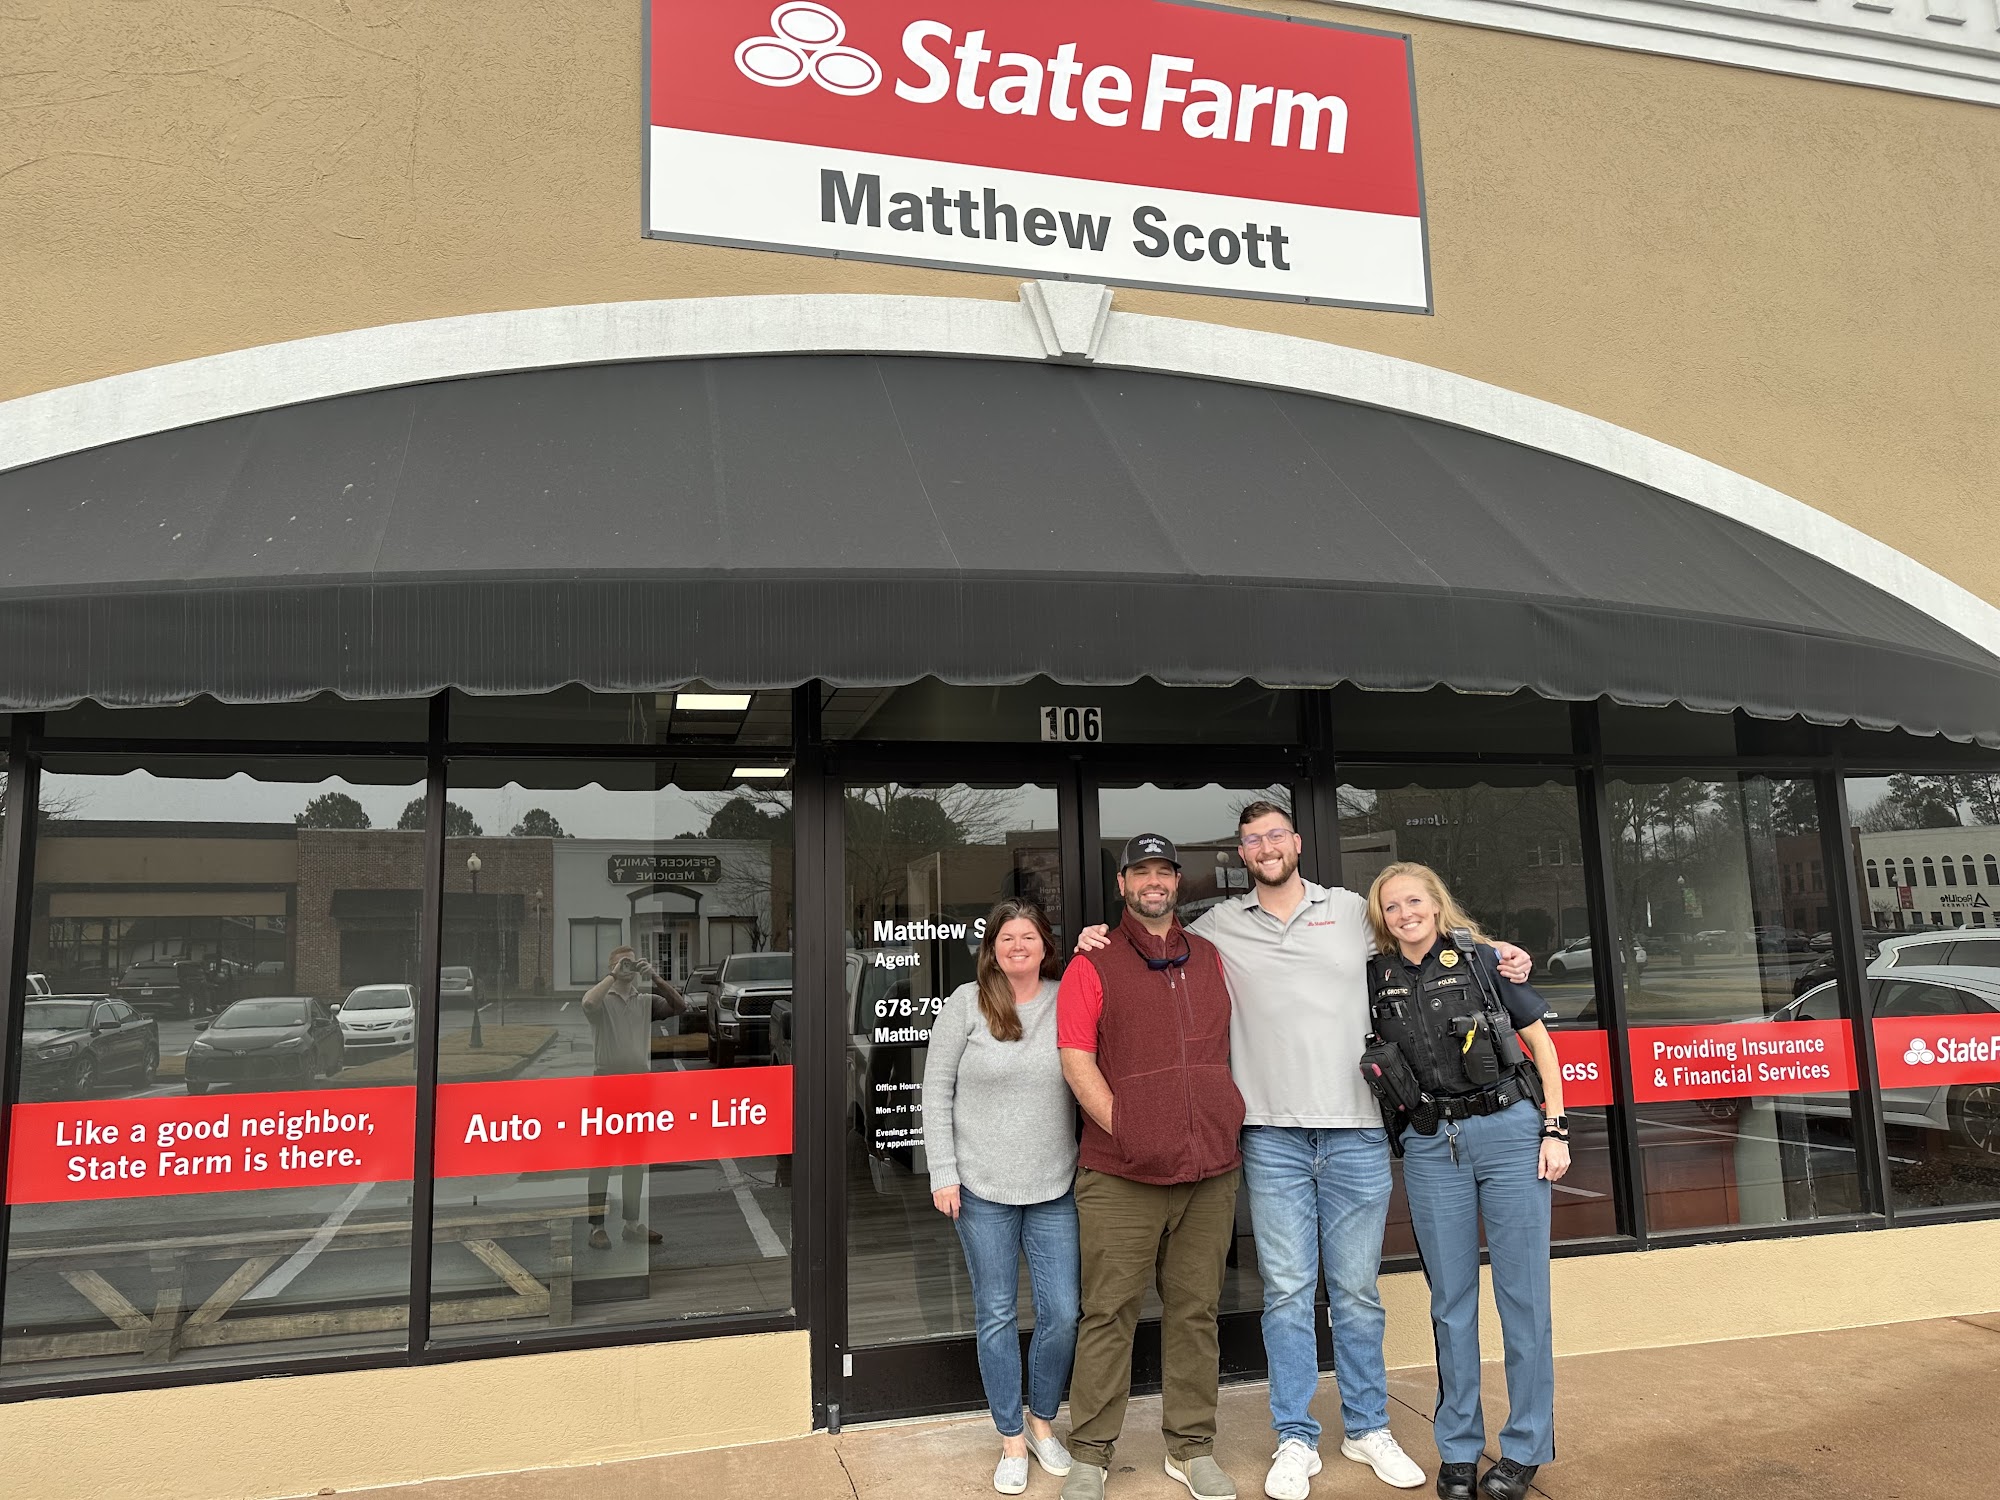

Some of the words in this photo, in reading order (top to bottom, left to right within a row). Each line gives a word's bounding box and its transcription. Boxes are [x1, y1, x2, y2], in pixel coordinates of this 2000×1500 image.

[820, 168, 1112, 252] Matthew
[1132, 204, 1291, 271] Scott
[1045, 707, 1100, 741] 106
[873, 919, 967, 942] Matthew
[874, 952, 920, 970] Agent
[1437, 977, 1457, 986] POLICE
[1653, 1039, 1737, 1061] Providing
[1742, 1038, 1825, 1056] Insurance
[1562, 1062, 1599, 1082] ess
[1653, 1067, 1668, 1087] &
[1673, 1063, 1752, 1086] Financial
[1758, 1061, 1830, 1082] Services
[876, 1083, 897, 1091] Office
[899, 1082, 923, 1090] Hours:
[56, 1119, 119, 1147] Like
[130, 1123, 146, 1143] a
[157, 1113, 230, 1148] good
[241, 1108, 375, 1141] neighbor,
[463, 1114, 542, 1144] Auto
[580, 1106, 675, 1137] Home
[711, 1098, 767, 1128] Life
[876, 1128, 908, 1137] Evenings
[909, 1127, 923, 1135] and
[876, 1140, 885, 1150] by
[66, 1155, 147, 1182] State
[158, 1151, 232, 1177] Farm
[244, 1147, 268, 1172] is
[278, 1144, 362, 1170] there.
